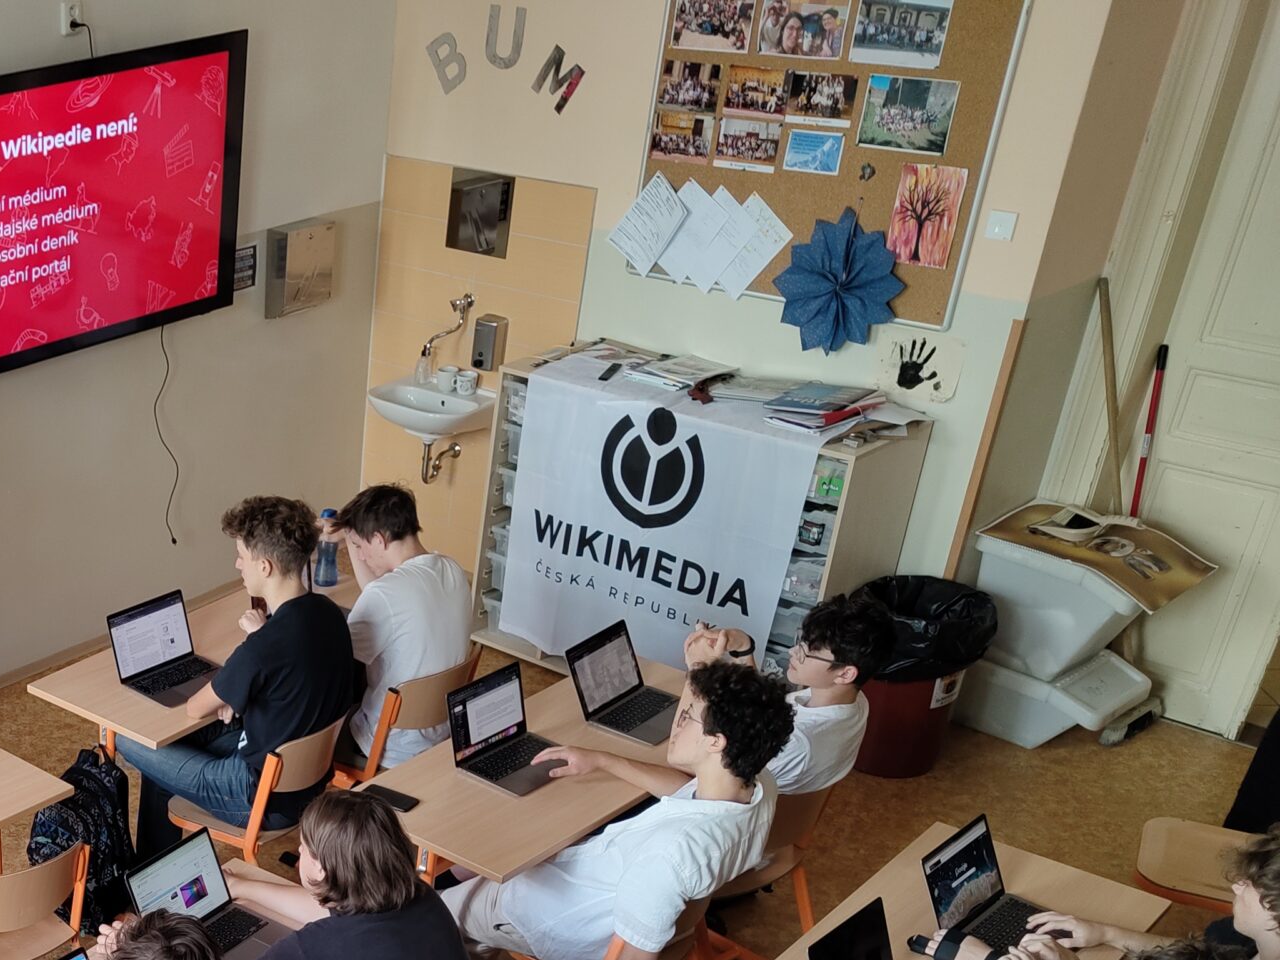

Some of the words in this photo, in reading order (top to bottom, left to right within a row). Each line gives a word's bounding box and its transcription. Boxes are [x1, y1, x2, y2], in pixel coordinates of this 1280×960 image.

[0, 122, 92, 161] Wikipedie
[96, 112, 138, 141] není:
[8, 184, 67, 211] médium
[41, 203, 98, 228] médium
[41, 229, 79, 253] deník
[31, 254, 71, 283] portál
[534, 508, 749, 617] WIKIMEDIA
[535, 558, 596, 590] ČESKÁ
[609, 586, 717, 631] REPUBL
